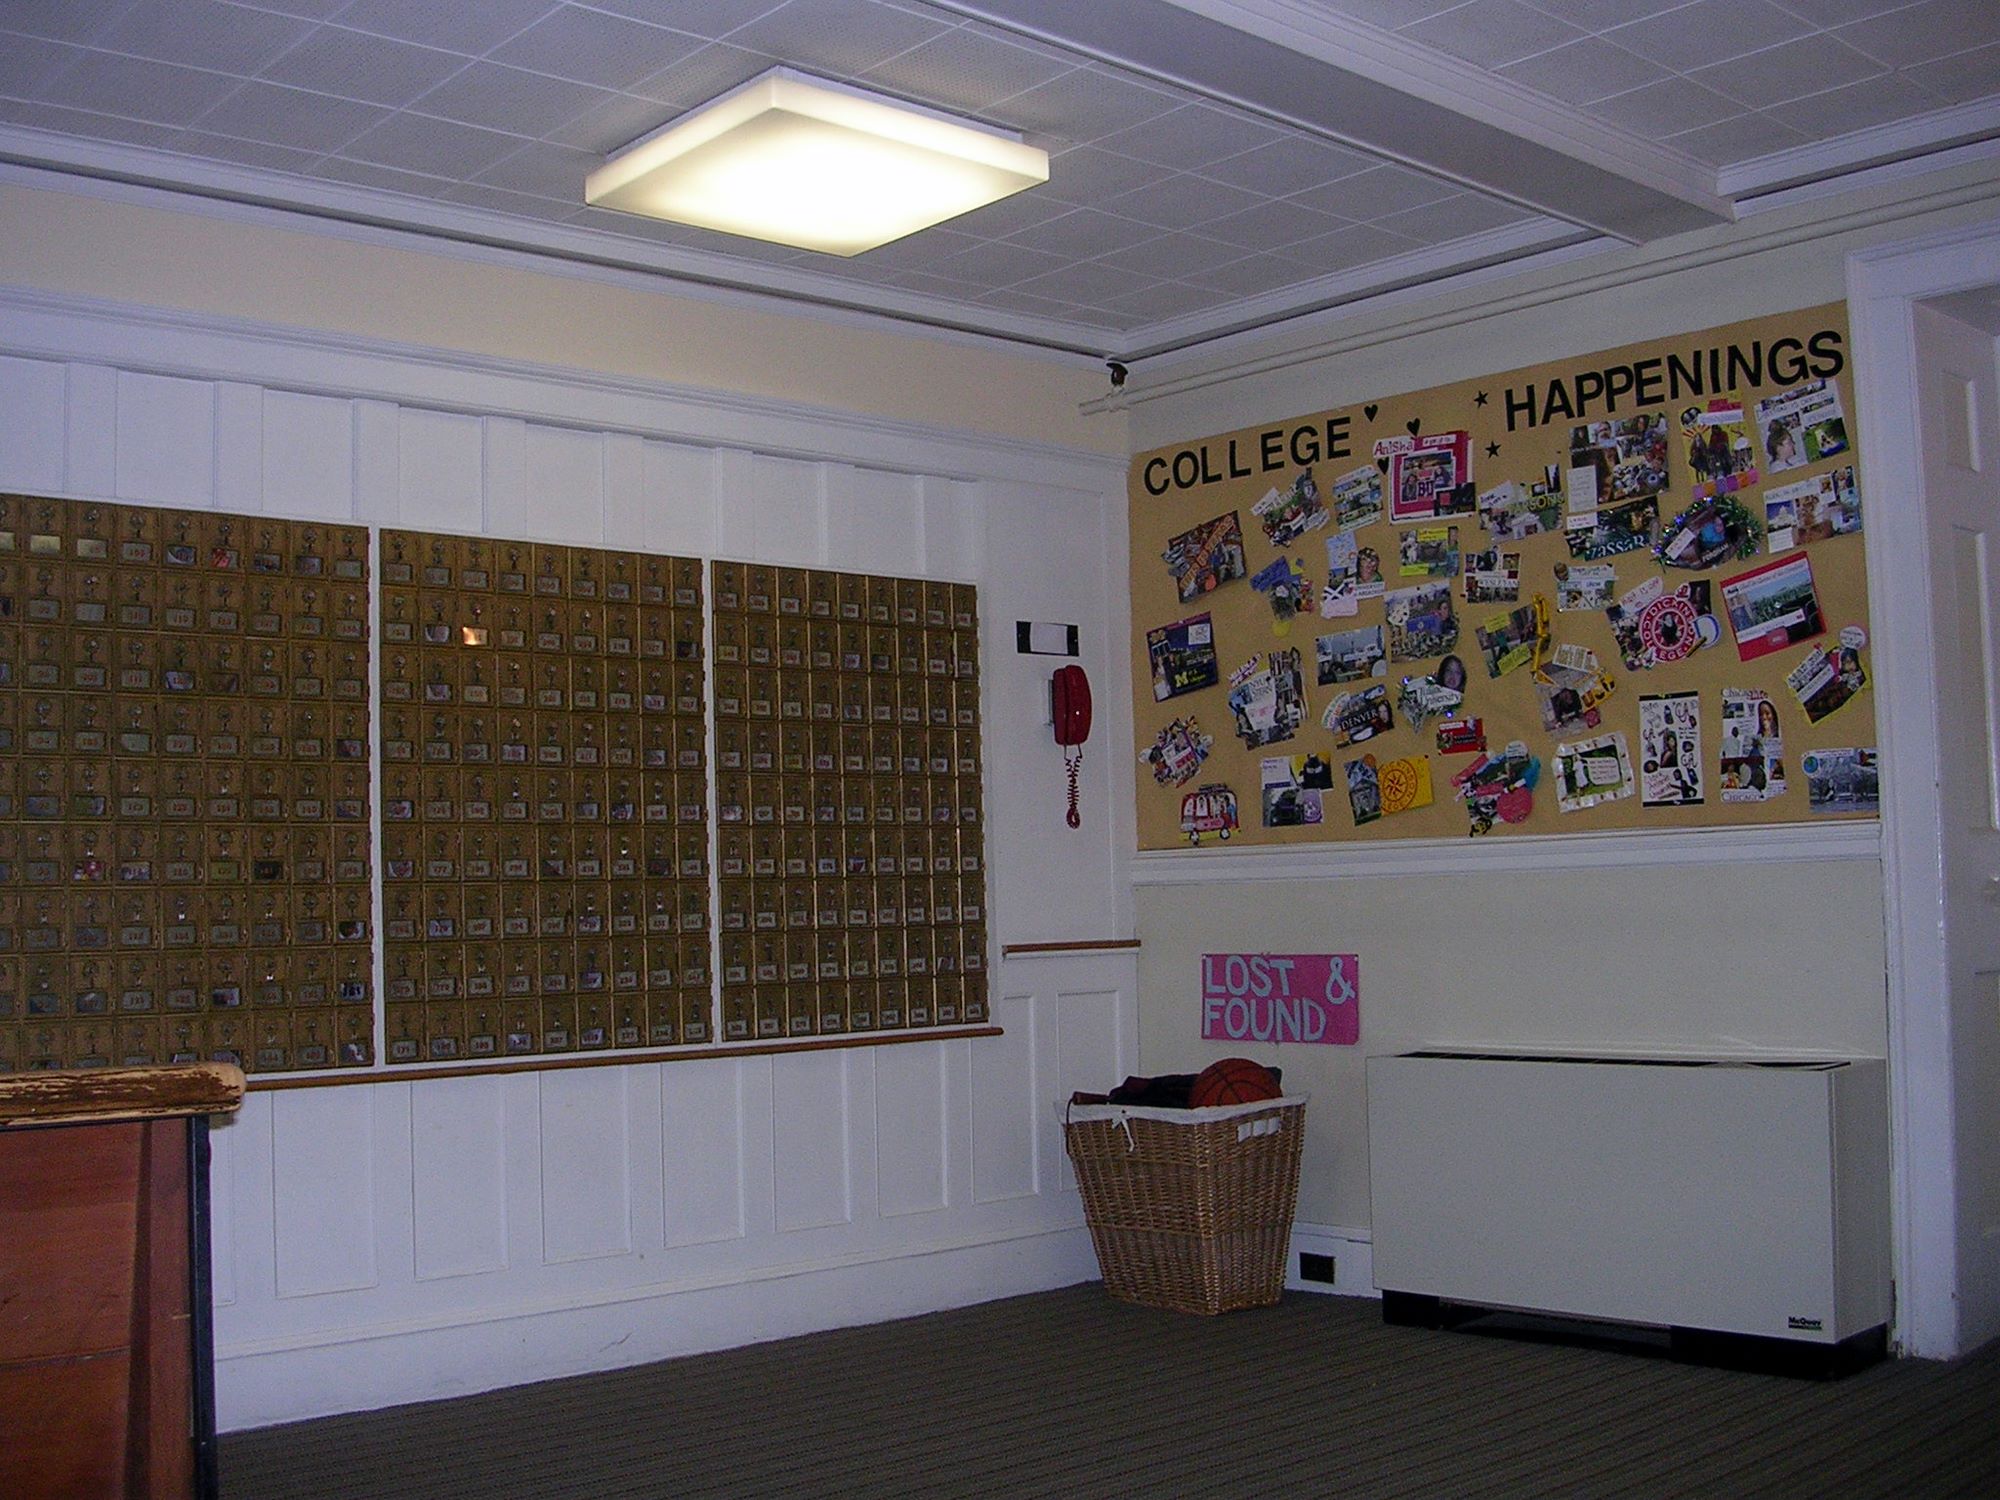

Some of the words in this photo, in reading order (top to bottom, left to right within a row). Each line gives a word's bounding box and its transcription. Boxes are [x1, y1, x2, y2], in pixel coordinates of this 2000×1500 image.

[1144, 416, 1351, 495] COLLEGE
[1505, 330, 1844, 432] HAPPENINGS
[1374, 439, 1414, 456] Anisha
[1418, 480, 1433, 497] BU
[1340, 708, 1379, 731] DENVER
[1205, 955, 1295, 997] LOST
[1324, 956, 1356, 1005] &
[1203, 997, 1327, 1041] FOUND
